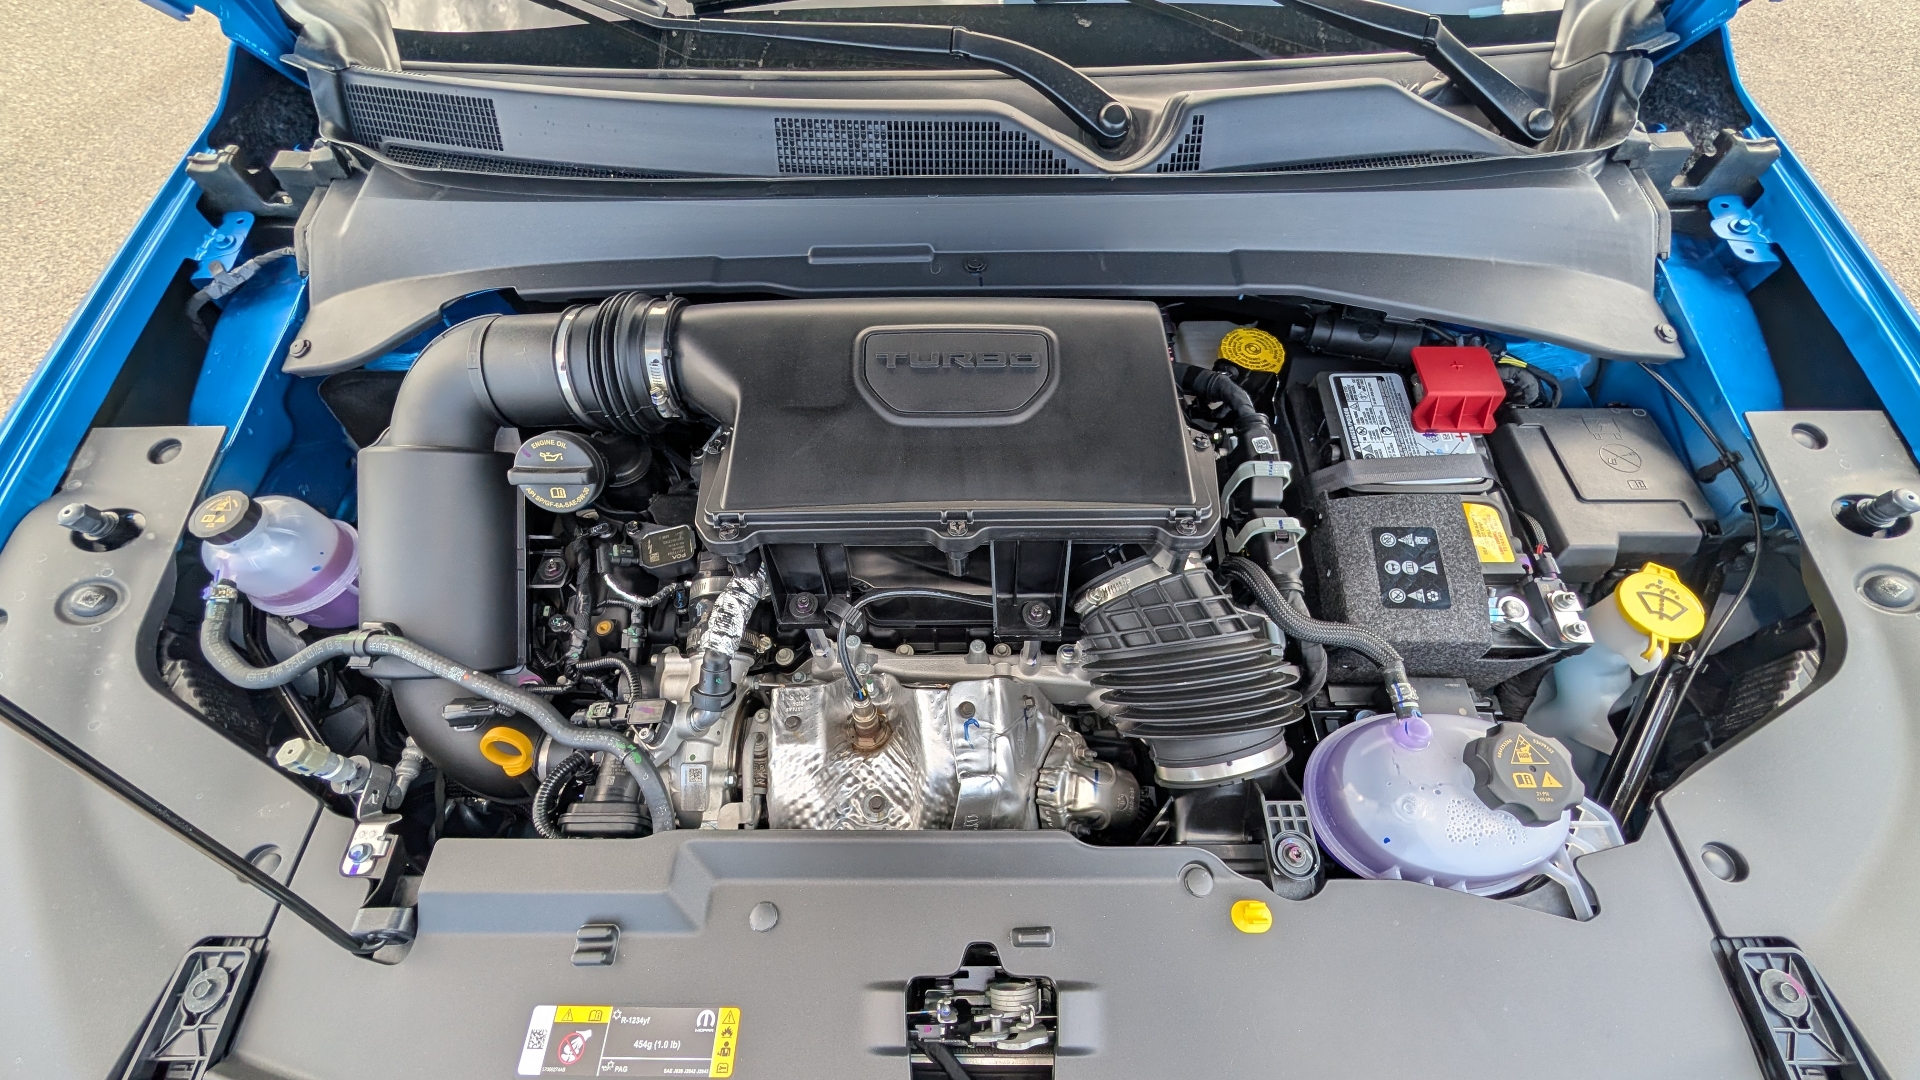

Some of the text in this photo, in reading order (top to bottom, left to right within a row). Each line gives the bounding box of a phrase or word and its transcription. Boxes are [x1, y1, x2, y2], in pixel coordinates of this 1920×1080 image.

[875, 351, 1041, 369] TURBO
[531, 439, 567, 450] ENGINE OIL
[525, 487, 536, 498] API
[369, 642, 389, 652] HEATER
[245, 672, 268, 682] HEATER
[620, 1016, 651, 1026] R-1234yf
[633, 1040, 681, 1050] 454g (1.0 lb)
